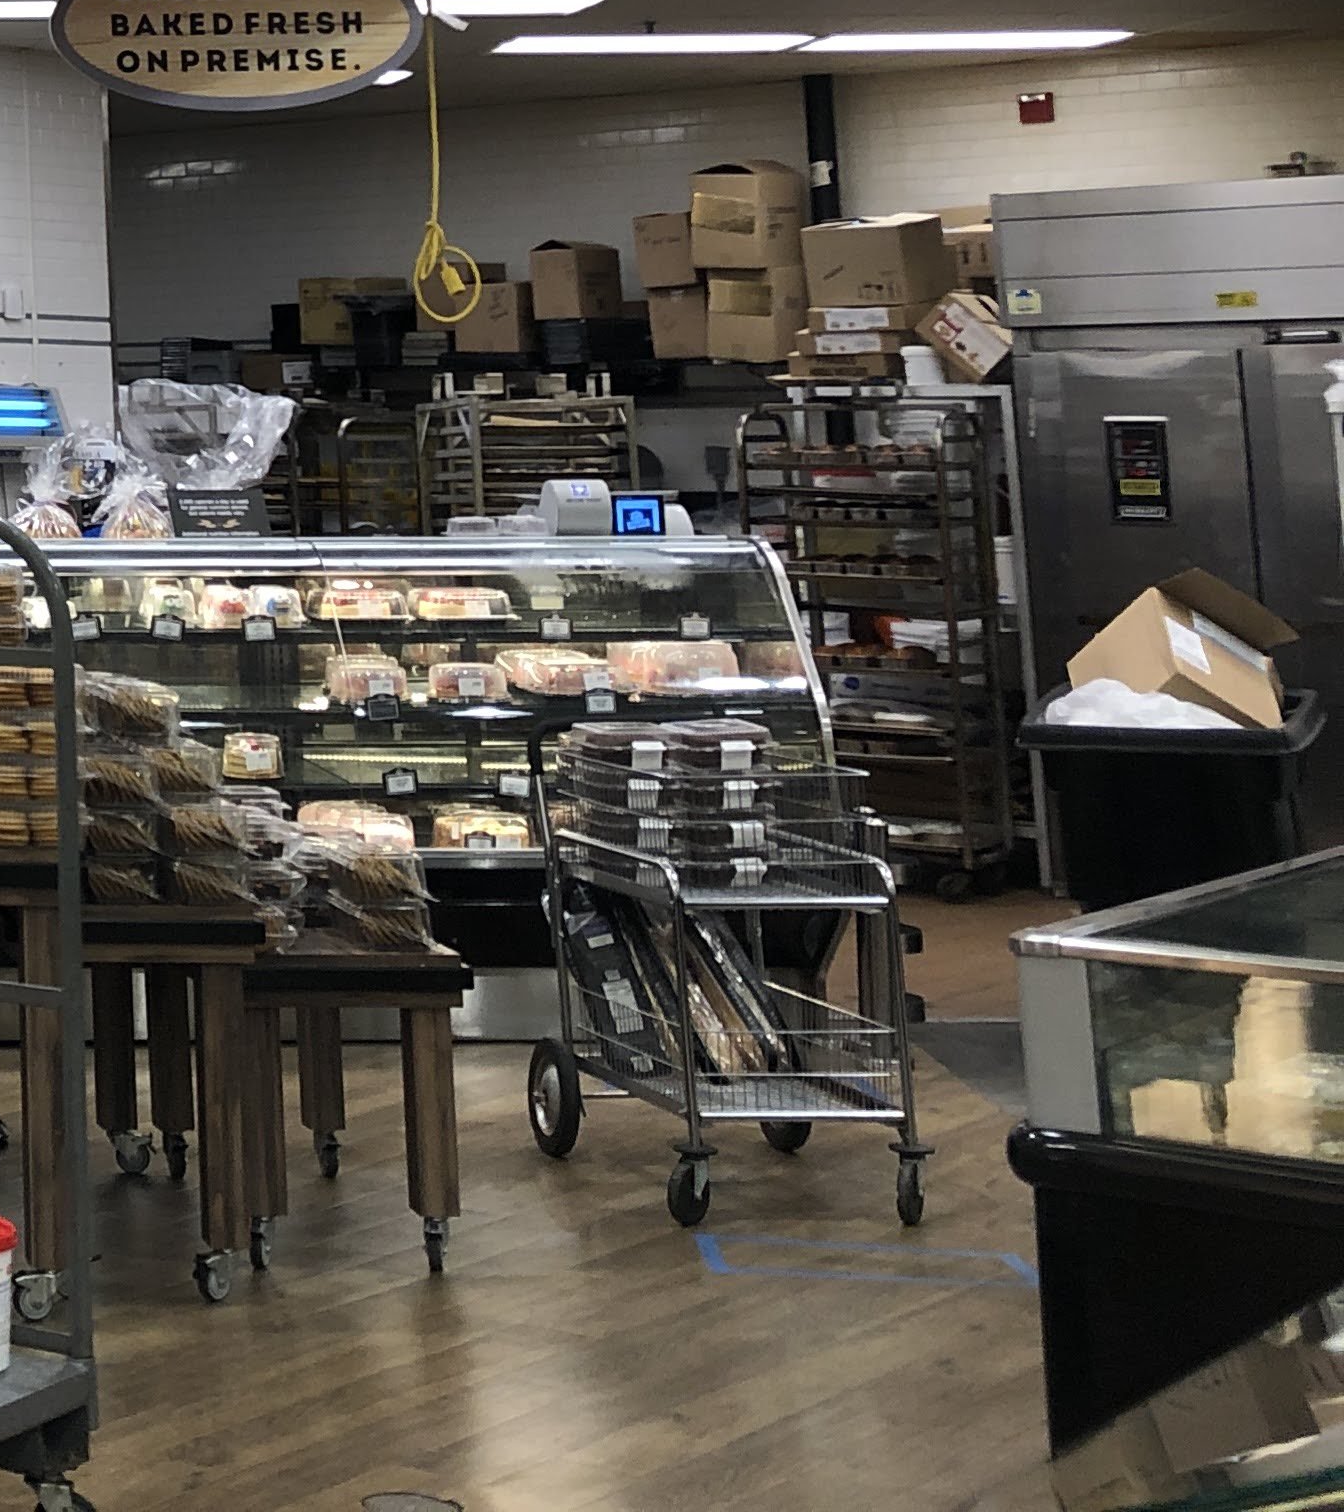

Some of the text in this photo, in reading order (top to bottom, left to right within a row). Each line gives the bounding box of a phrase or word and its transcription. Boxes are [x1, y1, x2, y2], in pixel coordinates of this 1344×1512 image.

[110, 10, 363, 37] BAKED FRESH
[116, 48, 361, 74] ON PREMISE.
